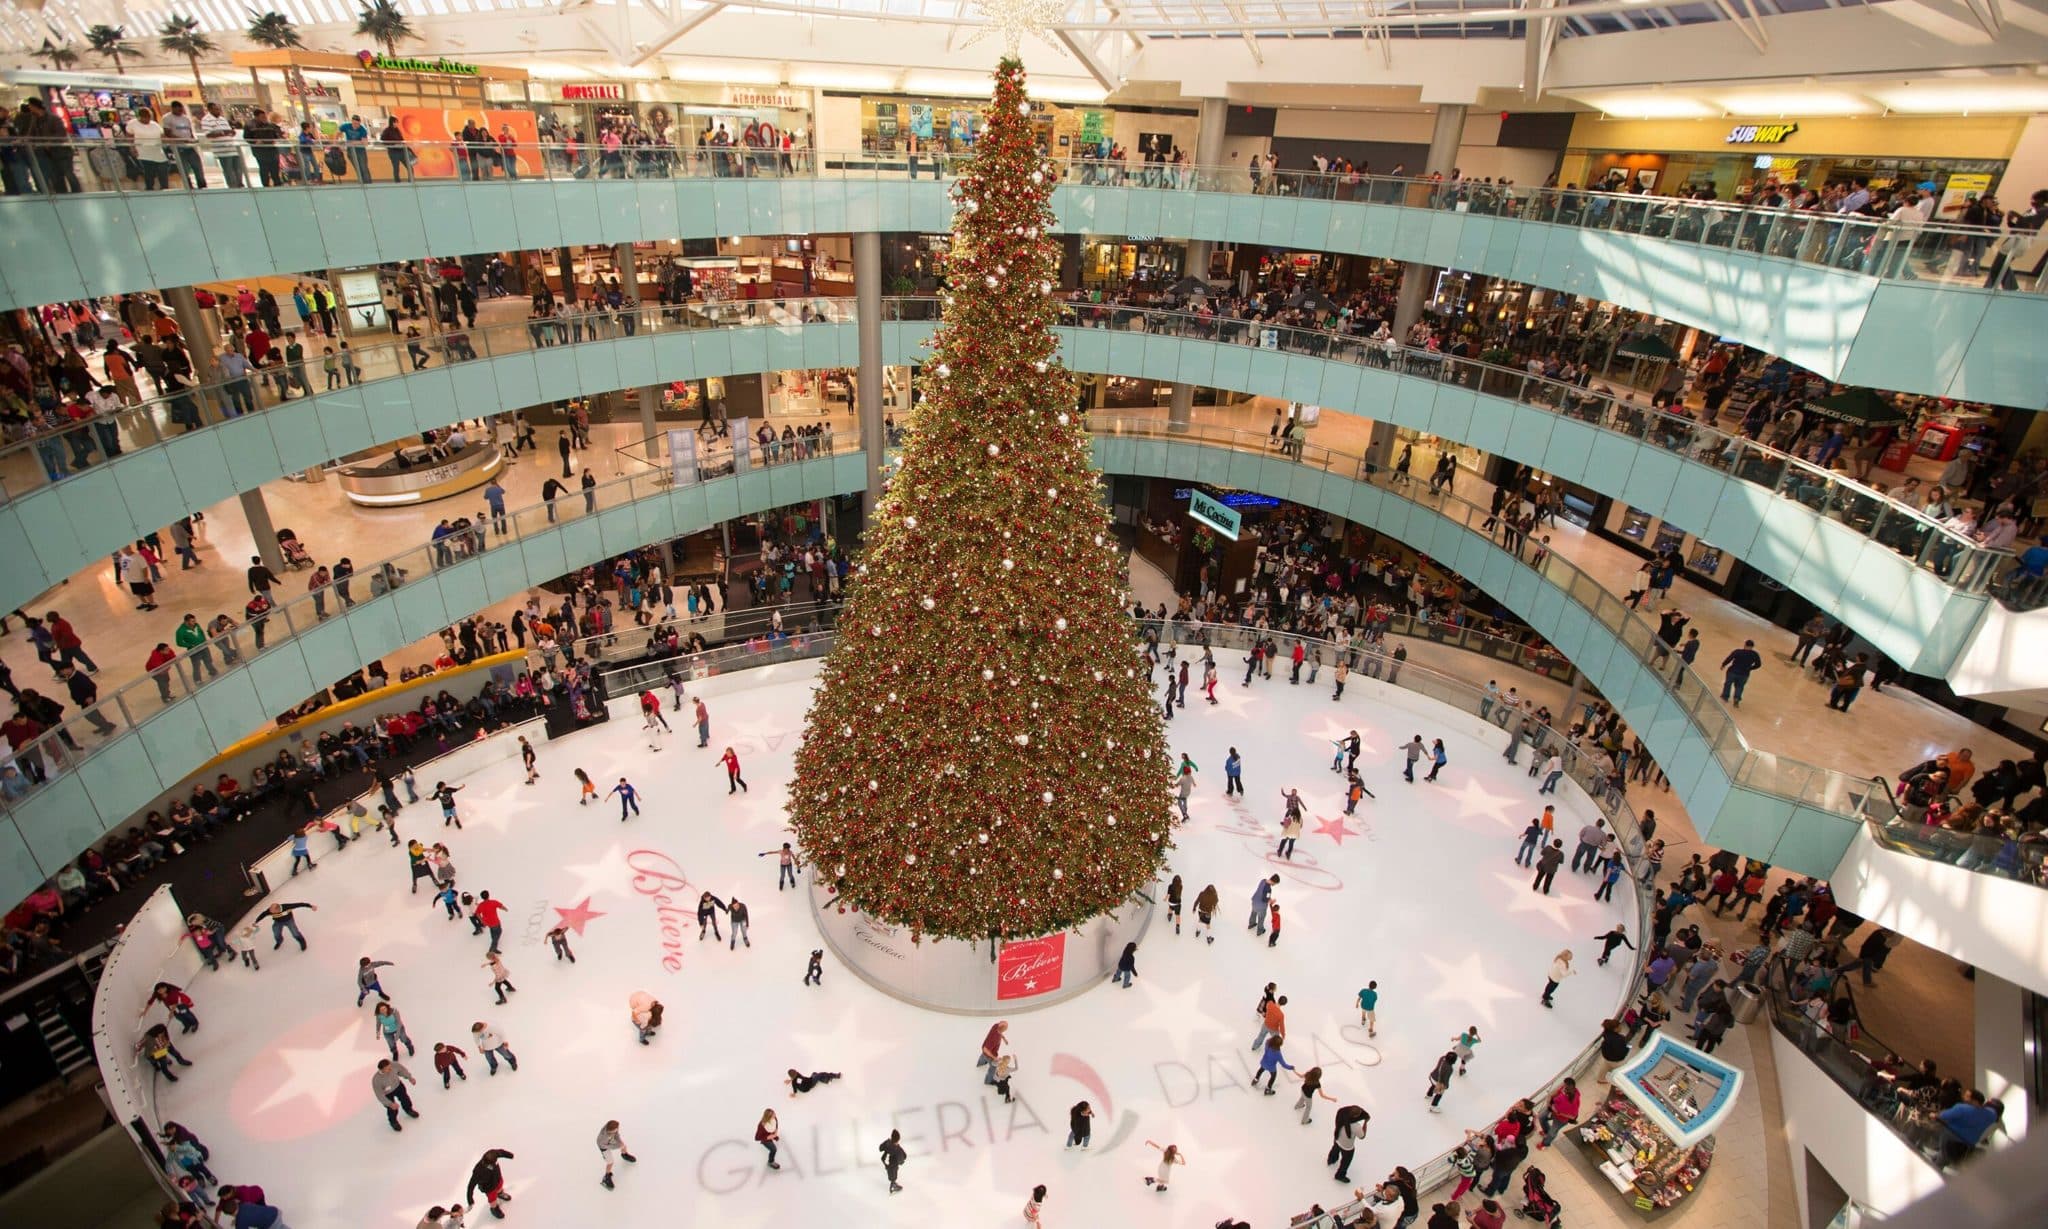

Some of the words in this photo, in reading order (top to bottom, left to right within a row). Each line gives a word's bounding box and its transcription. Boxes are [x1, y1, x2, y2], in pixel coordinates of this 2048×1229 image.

[376, 52, 434, 72] Jamba
[439, 56, 480, 74] Juice
[1727, 123, 1798, 143] SUBWAY
[1194, 497, 1206, 513] Mi
[1206, 505, 1234, 529] Cocina
[627, 850, 716, 974] Believe
[854, 925, 904, 960] Cadillac
[1001, 952, 1060, 981] Believe
[697, 1090, 1049, 1195] GALLERIA
